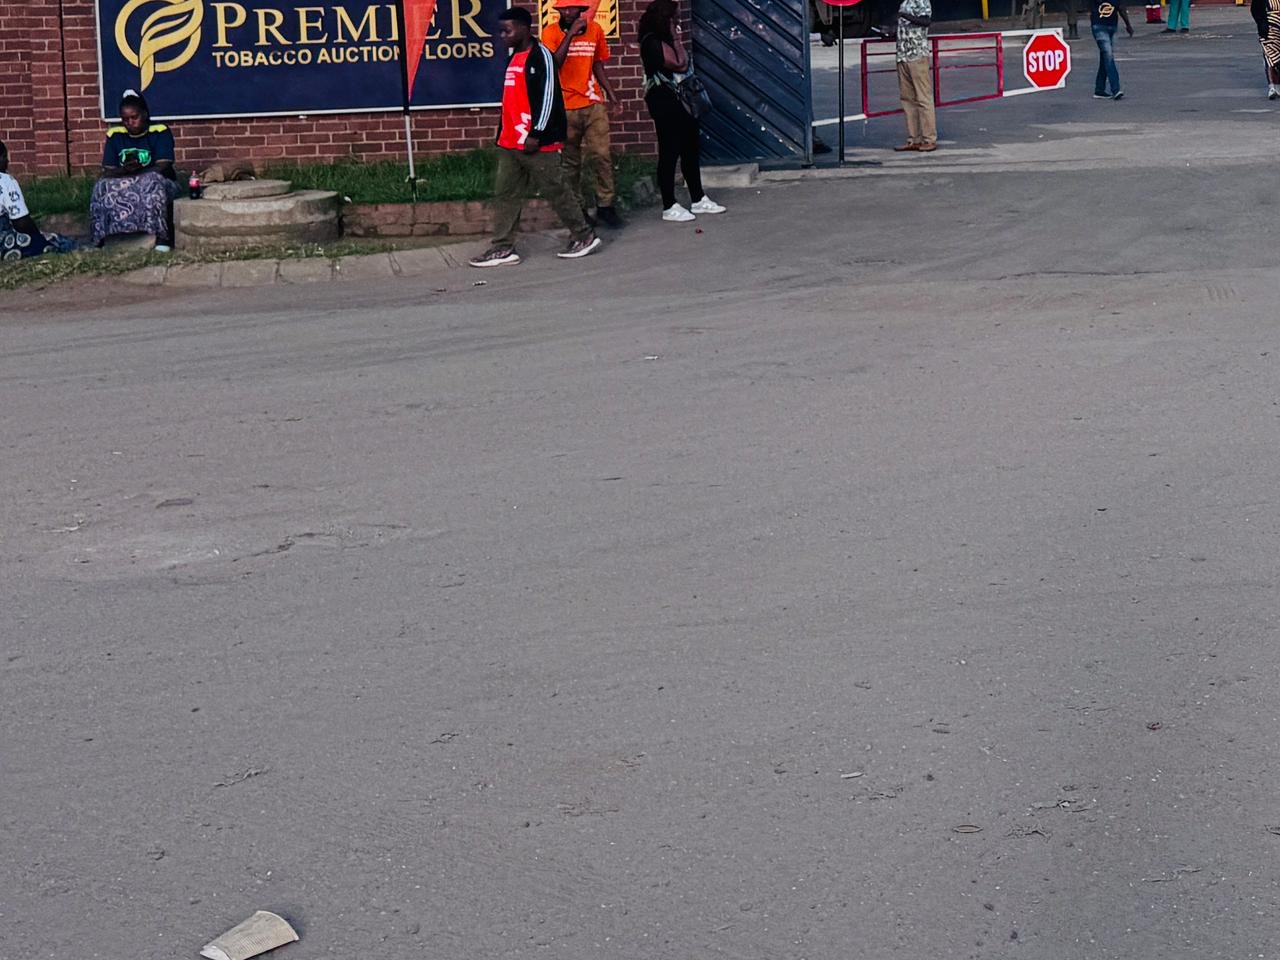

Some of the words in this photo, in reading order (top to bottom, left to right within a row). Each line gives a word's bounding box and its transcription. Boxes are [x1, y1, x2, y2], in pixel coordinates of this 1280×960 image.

[211, 48, 312, 68] TOBACCO
[425, 42, 494, 60] LOORS
[1028, 49, 1065, 73] STOP
